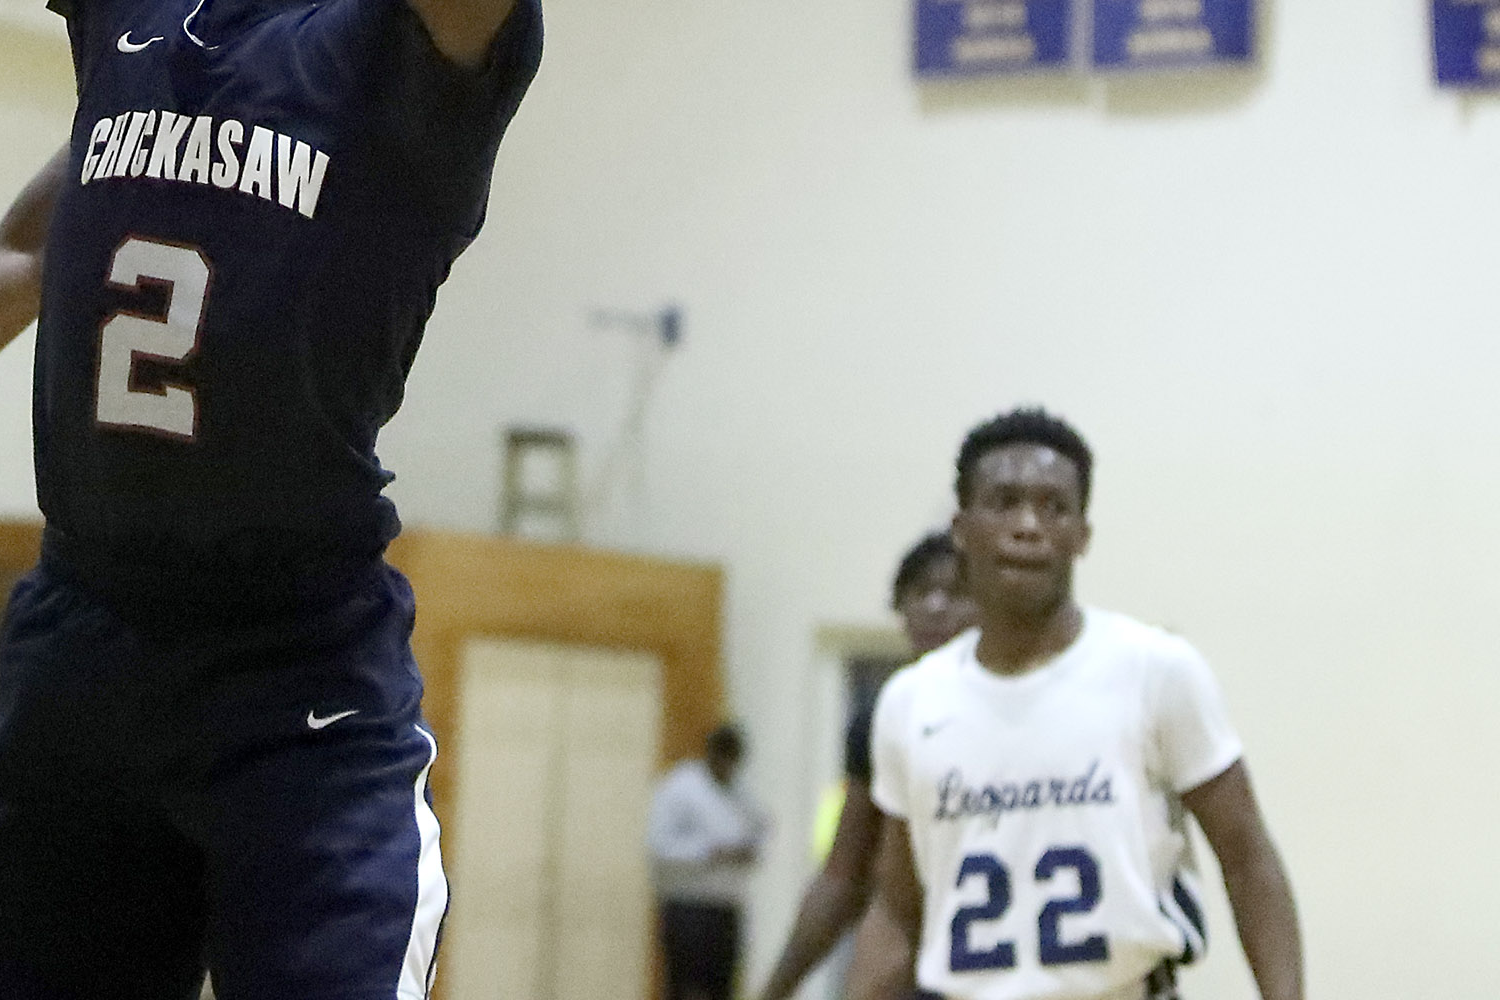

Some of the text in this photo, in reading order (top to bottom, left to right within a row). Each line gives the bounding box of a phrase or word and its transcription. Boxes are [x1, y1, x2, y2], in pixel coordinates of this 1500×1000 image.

[80, 108, 331, 220] CHICKASAW
[96, 236, 212, 440] 2
[934, 758, 1114, 830] Leopards
[949, 847, 1110, 973] 22
